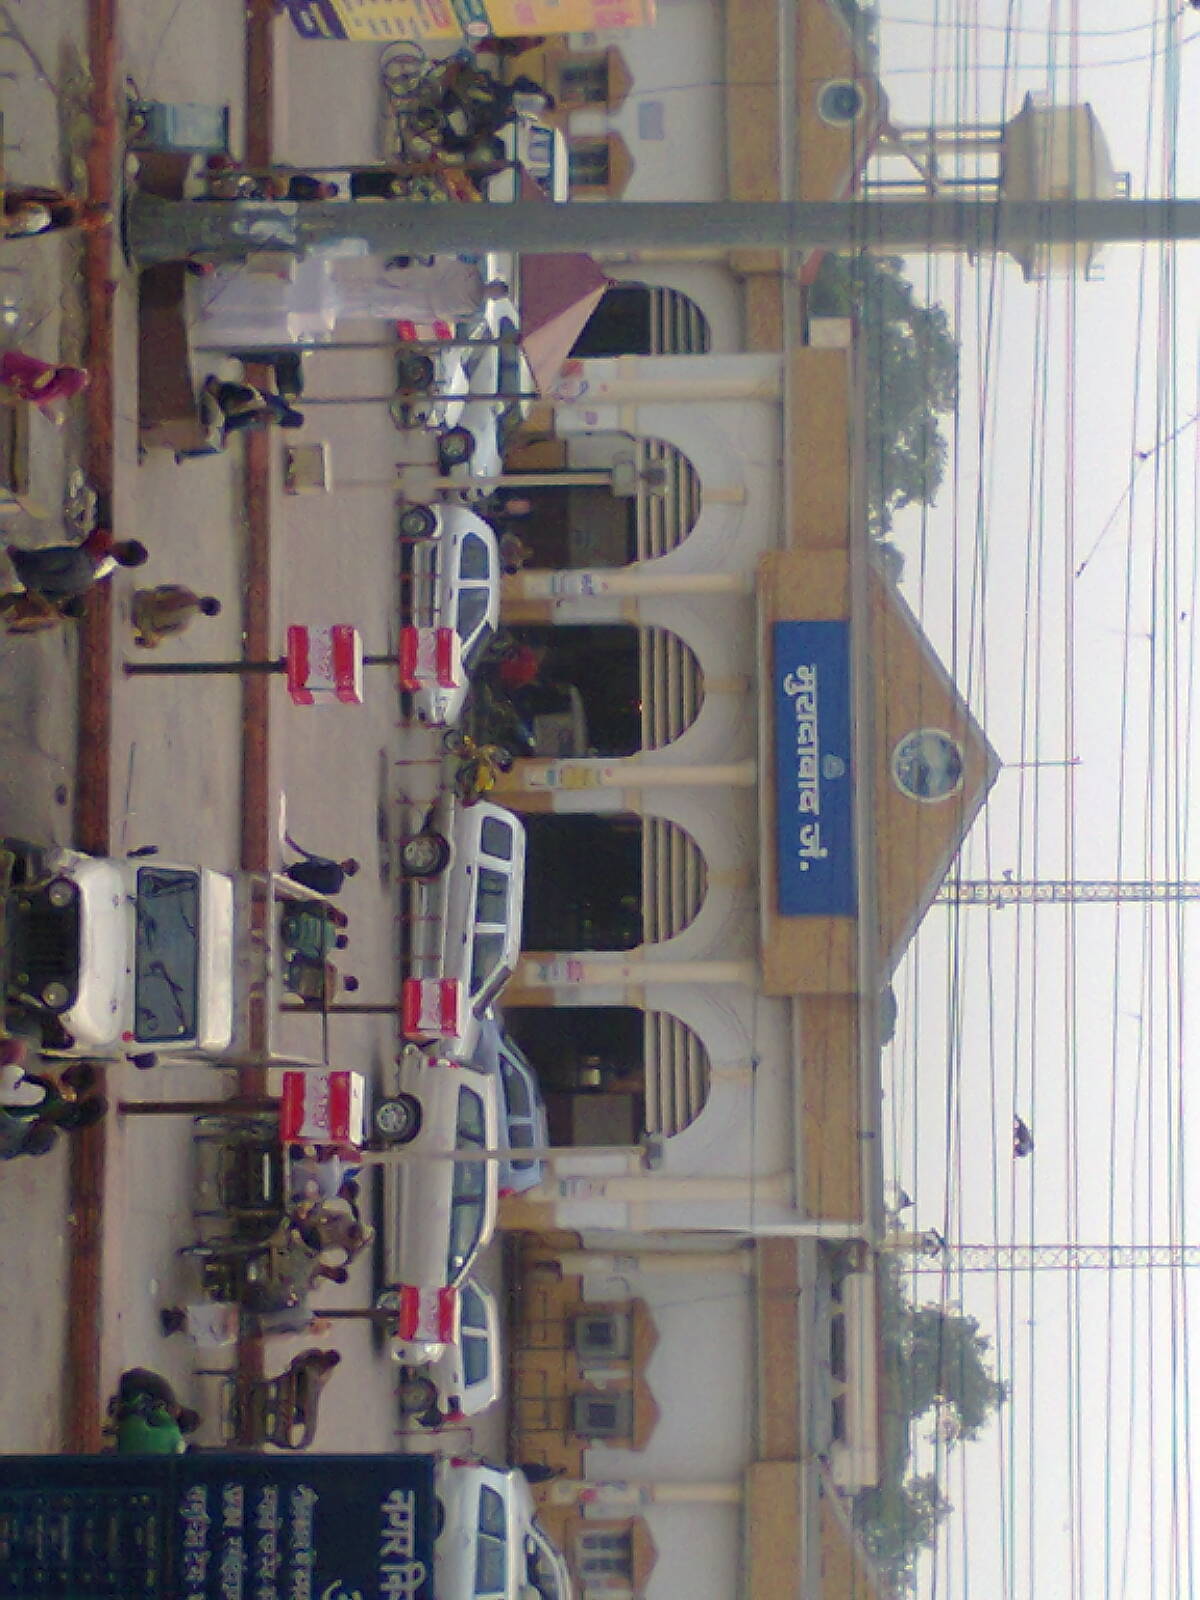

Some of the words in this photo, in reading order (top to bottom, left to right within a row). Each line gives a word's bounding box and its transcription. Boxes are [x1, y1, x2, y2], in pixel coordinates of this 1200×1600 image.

[783, 664, 820, 815] मुरादाबाद
[798, 822, 828, 872] जं.
[379, 1490, 416, 1558] नगर
